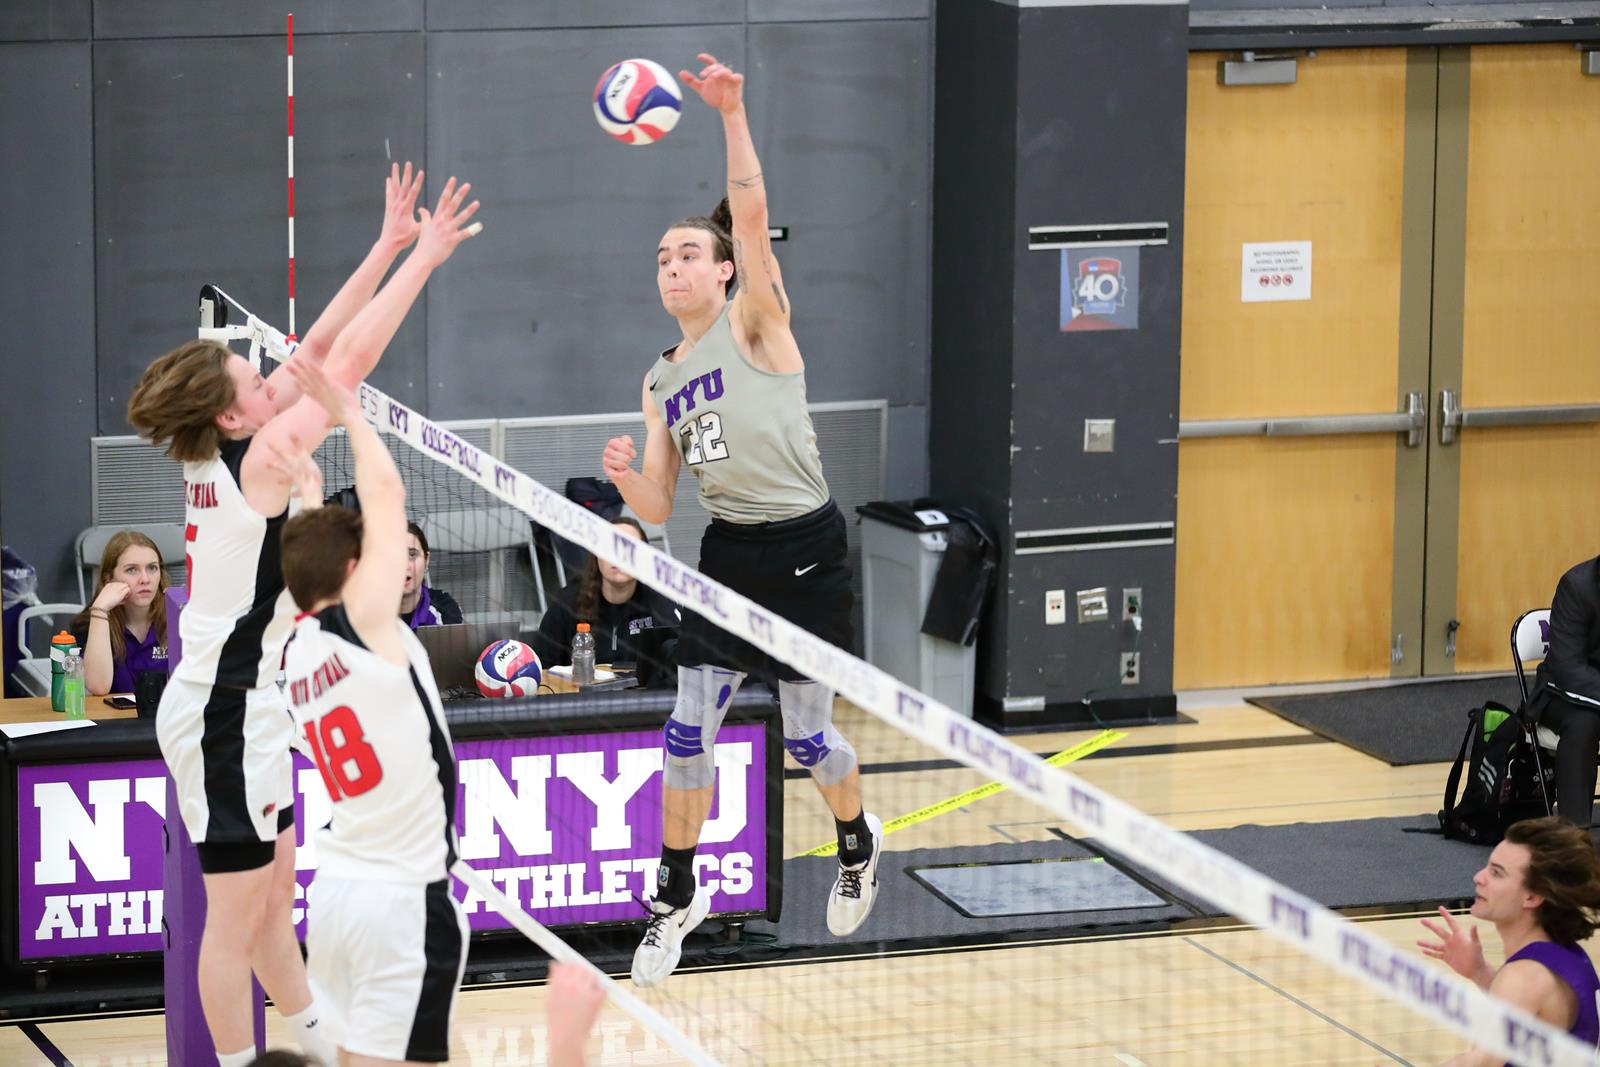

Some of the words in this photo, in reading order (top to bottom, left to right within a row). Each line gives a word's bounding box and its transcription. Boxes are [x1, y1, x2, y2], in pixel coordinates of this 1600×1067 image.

[1079, 274, 1119, 301] 40
[664, 367, 725, 428] NYU
[679, 410, 730, 466] 22
[152, 646, 168, 655] NY
[497, 645, 519, 662] NCAA
[303, 704, 383, 803] 18
[459, 851, 753, 914] ATHLETCS
